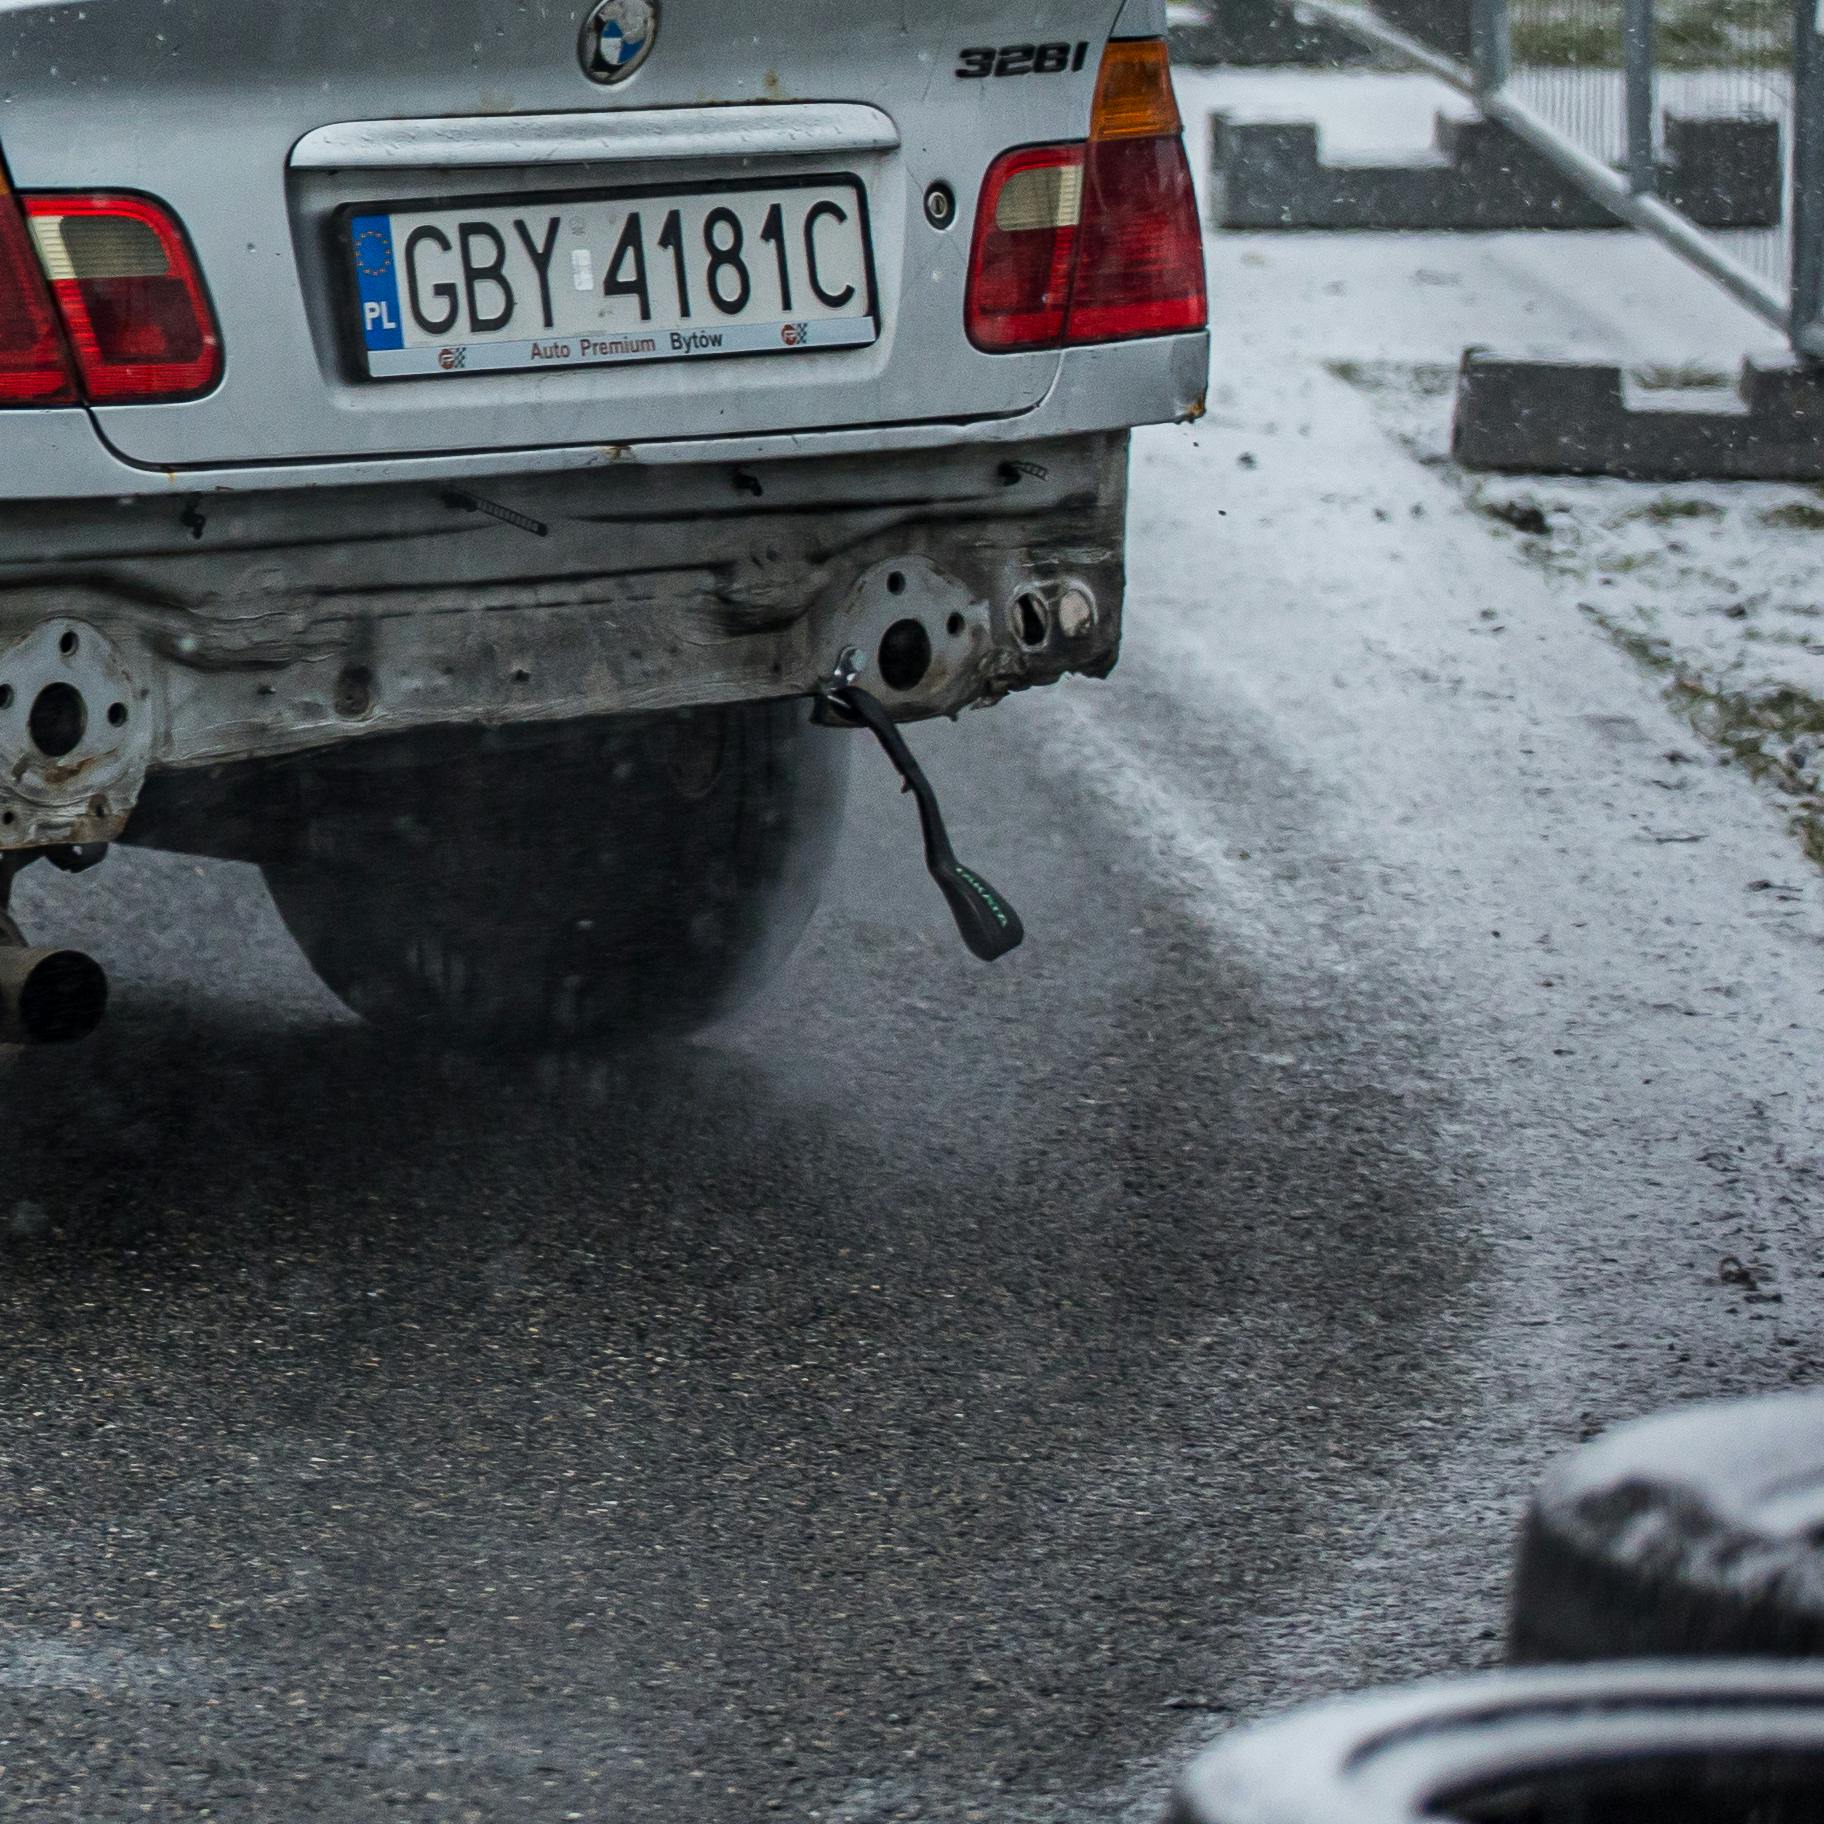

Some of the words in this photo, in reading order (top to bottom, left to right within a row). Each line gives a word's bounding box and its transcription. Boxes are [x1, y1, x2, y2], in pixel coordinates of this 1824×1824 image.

[405, 217, 561, 335] GBY
[603, 200, 856, 321] 4181C
[362, 301, 397, 331] PL
[531, 342, 571, 360] Auto
[580, 336, 656, 356] Premium
[670, 330, 723, 353] Bytów
